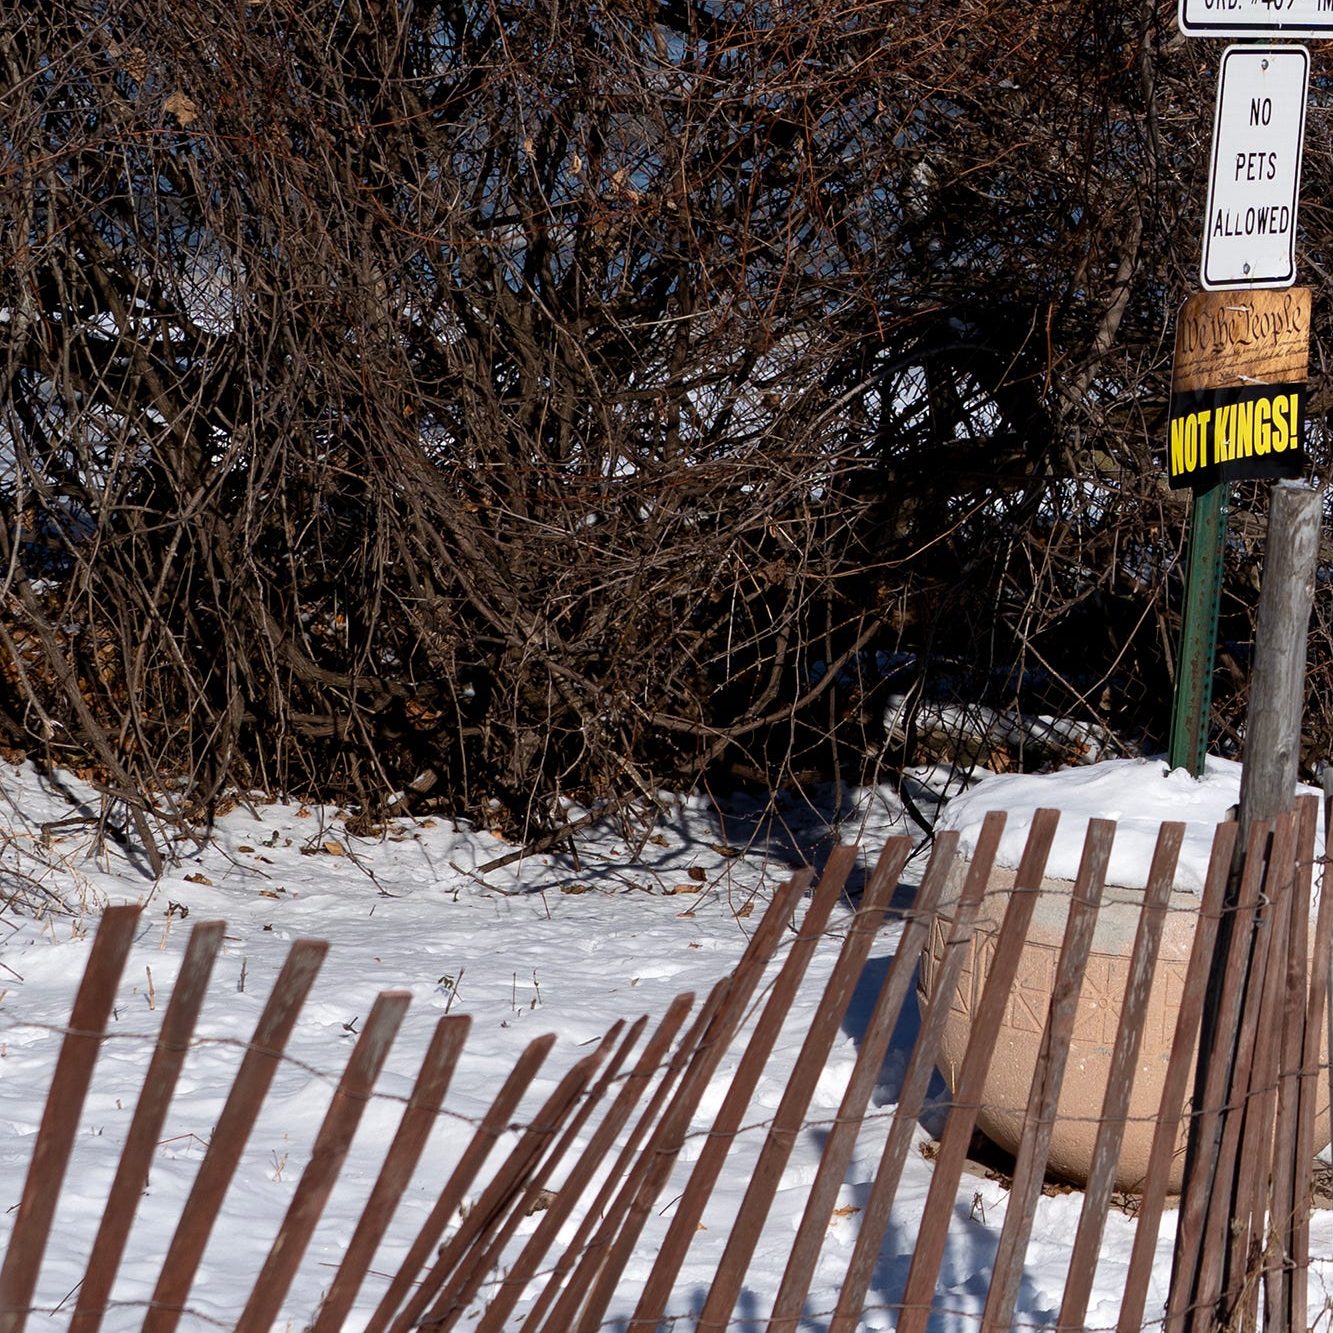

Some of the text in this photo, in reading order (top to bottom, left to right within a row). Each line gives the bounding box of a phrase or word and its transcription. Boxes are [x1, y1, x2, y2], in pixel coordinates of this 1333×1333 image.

[1249, 98, 1272, 126] NO
[1235, 152, 1277, 181] PETS
[1213, 206, 1289, 237] ALLOWED
[1237, 294, 1301, 346] People
[1171, 393, 1299, 477] NOT KINGS!
